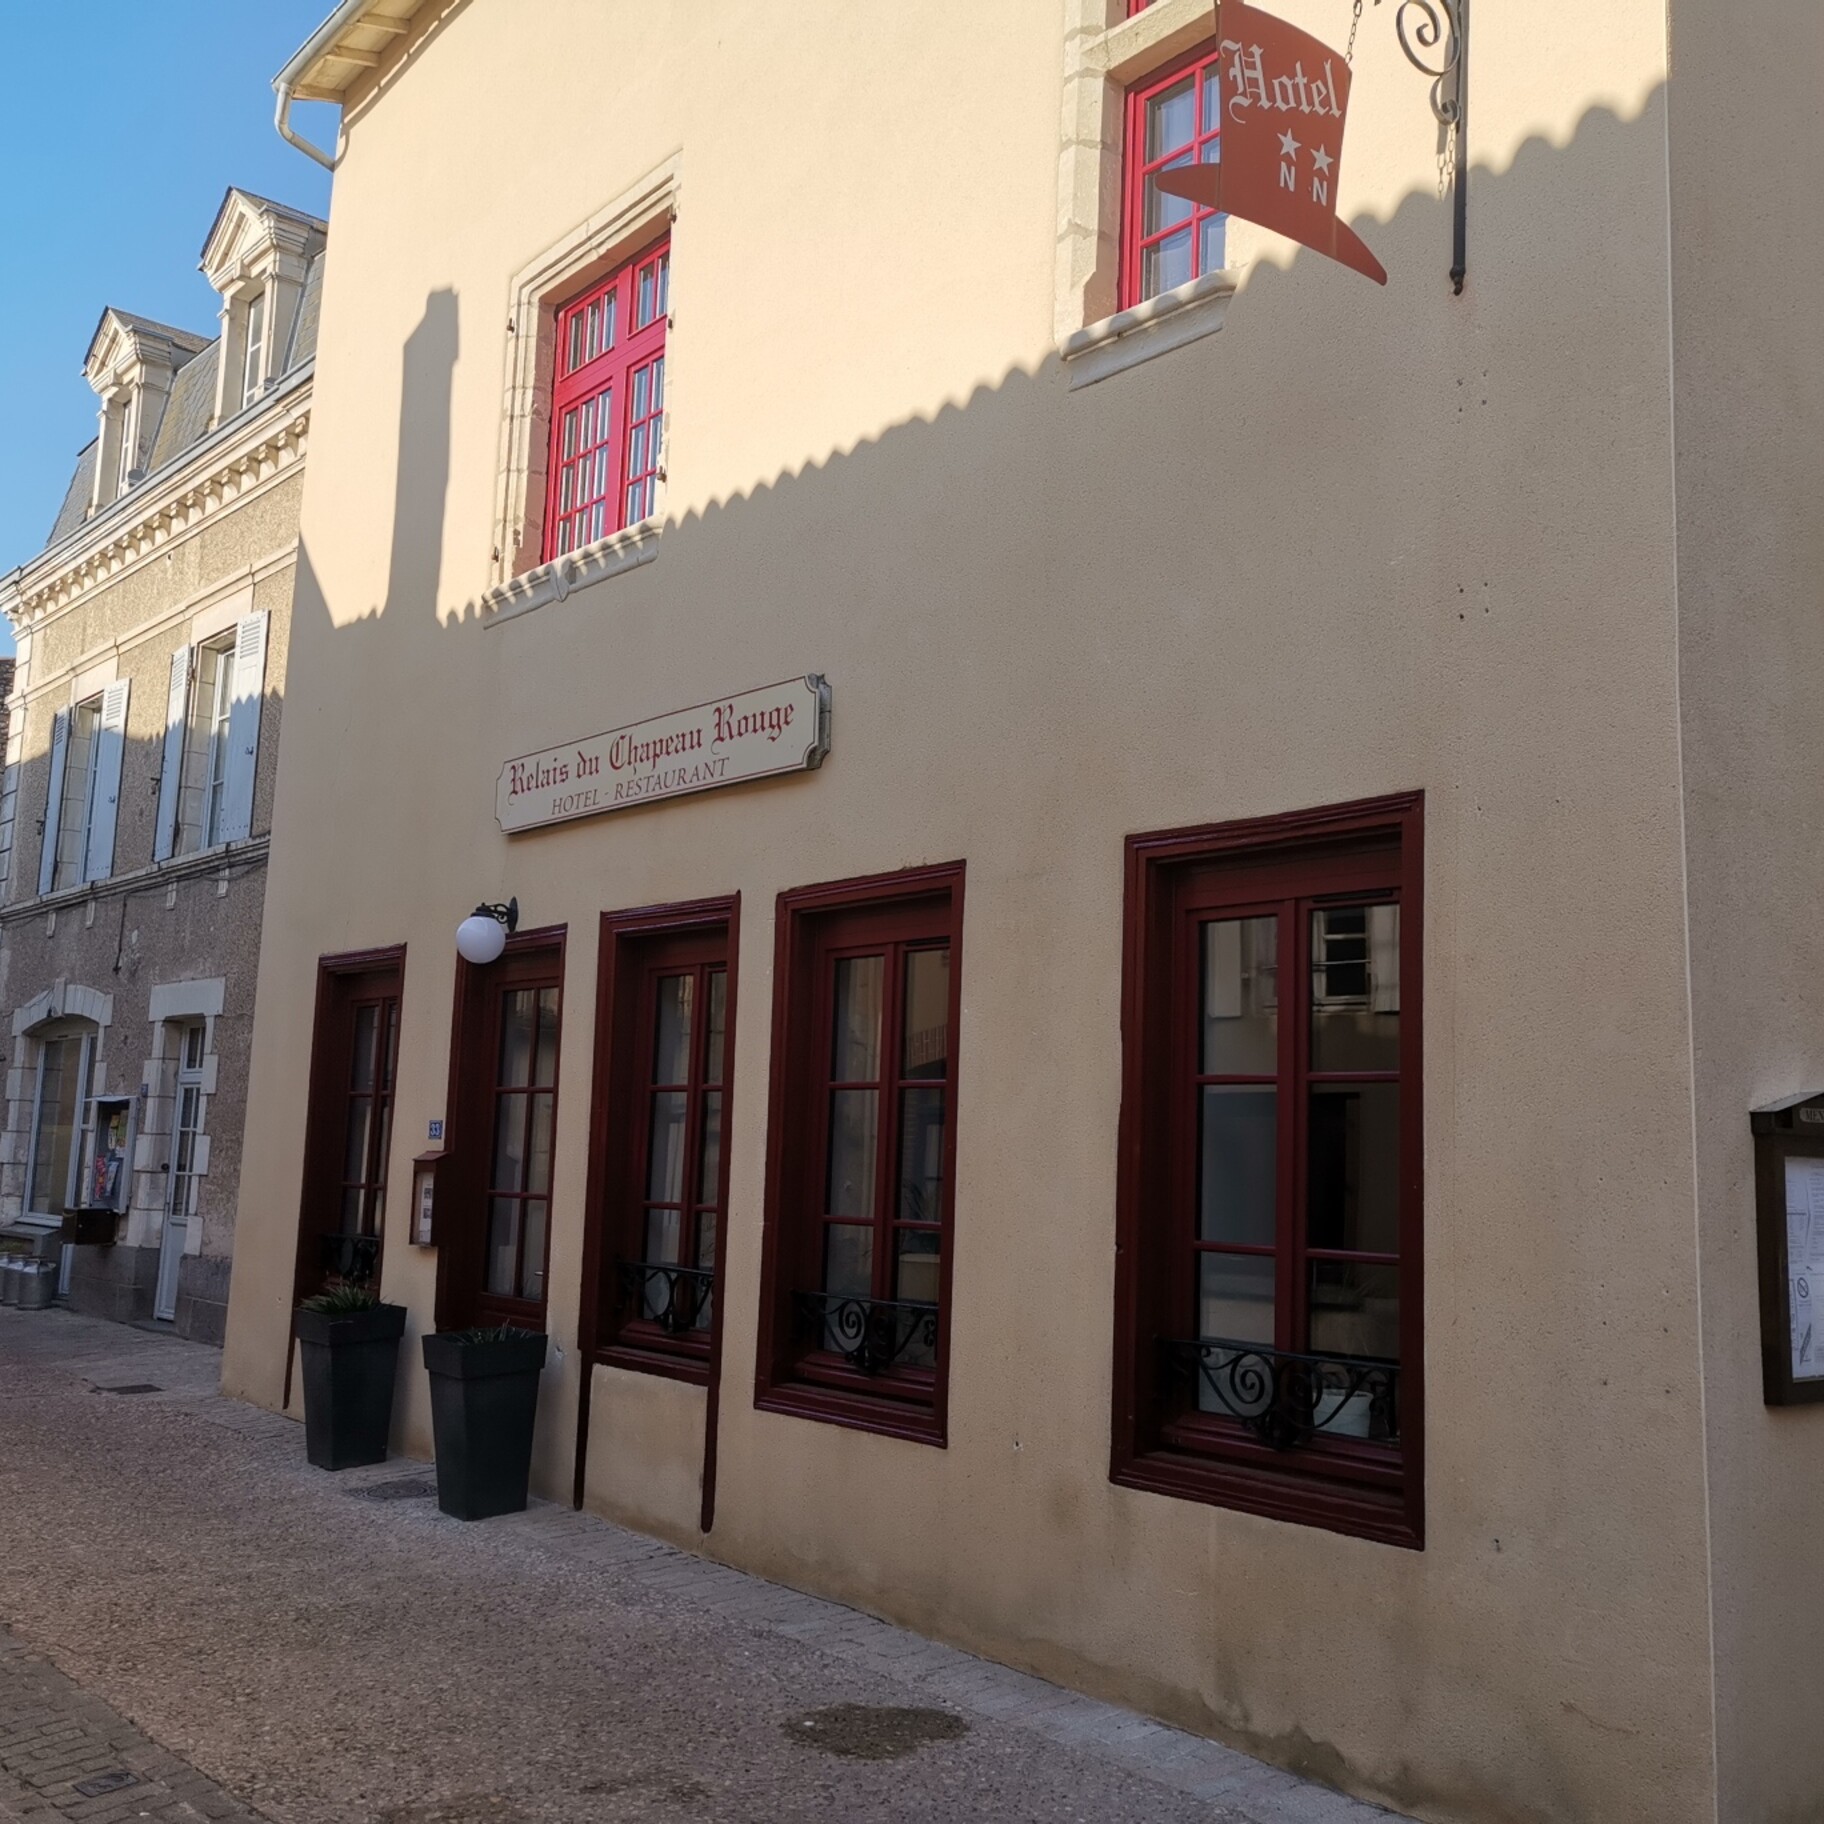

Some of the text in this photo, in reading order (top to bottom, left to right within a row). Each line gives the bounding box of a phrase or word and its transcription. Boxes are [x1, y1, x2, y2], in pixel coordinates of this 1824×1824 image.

[1220, 39, 1342, 123] Hotel
[1280, 161, 1328, 206] N N
[508, 703, 795, 806] Relais du Chapeau Rouge
[551, 790, 600, 815] HOTEL
[613, 757, 730, 800] RESTAURANT
[430, 1123, 440, 1136] 33
